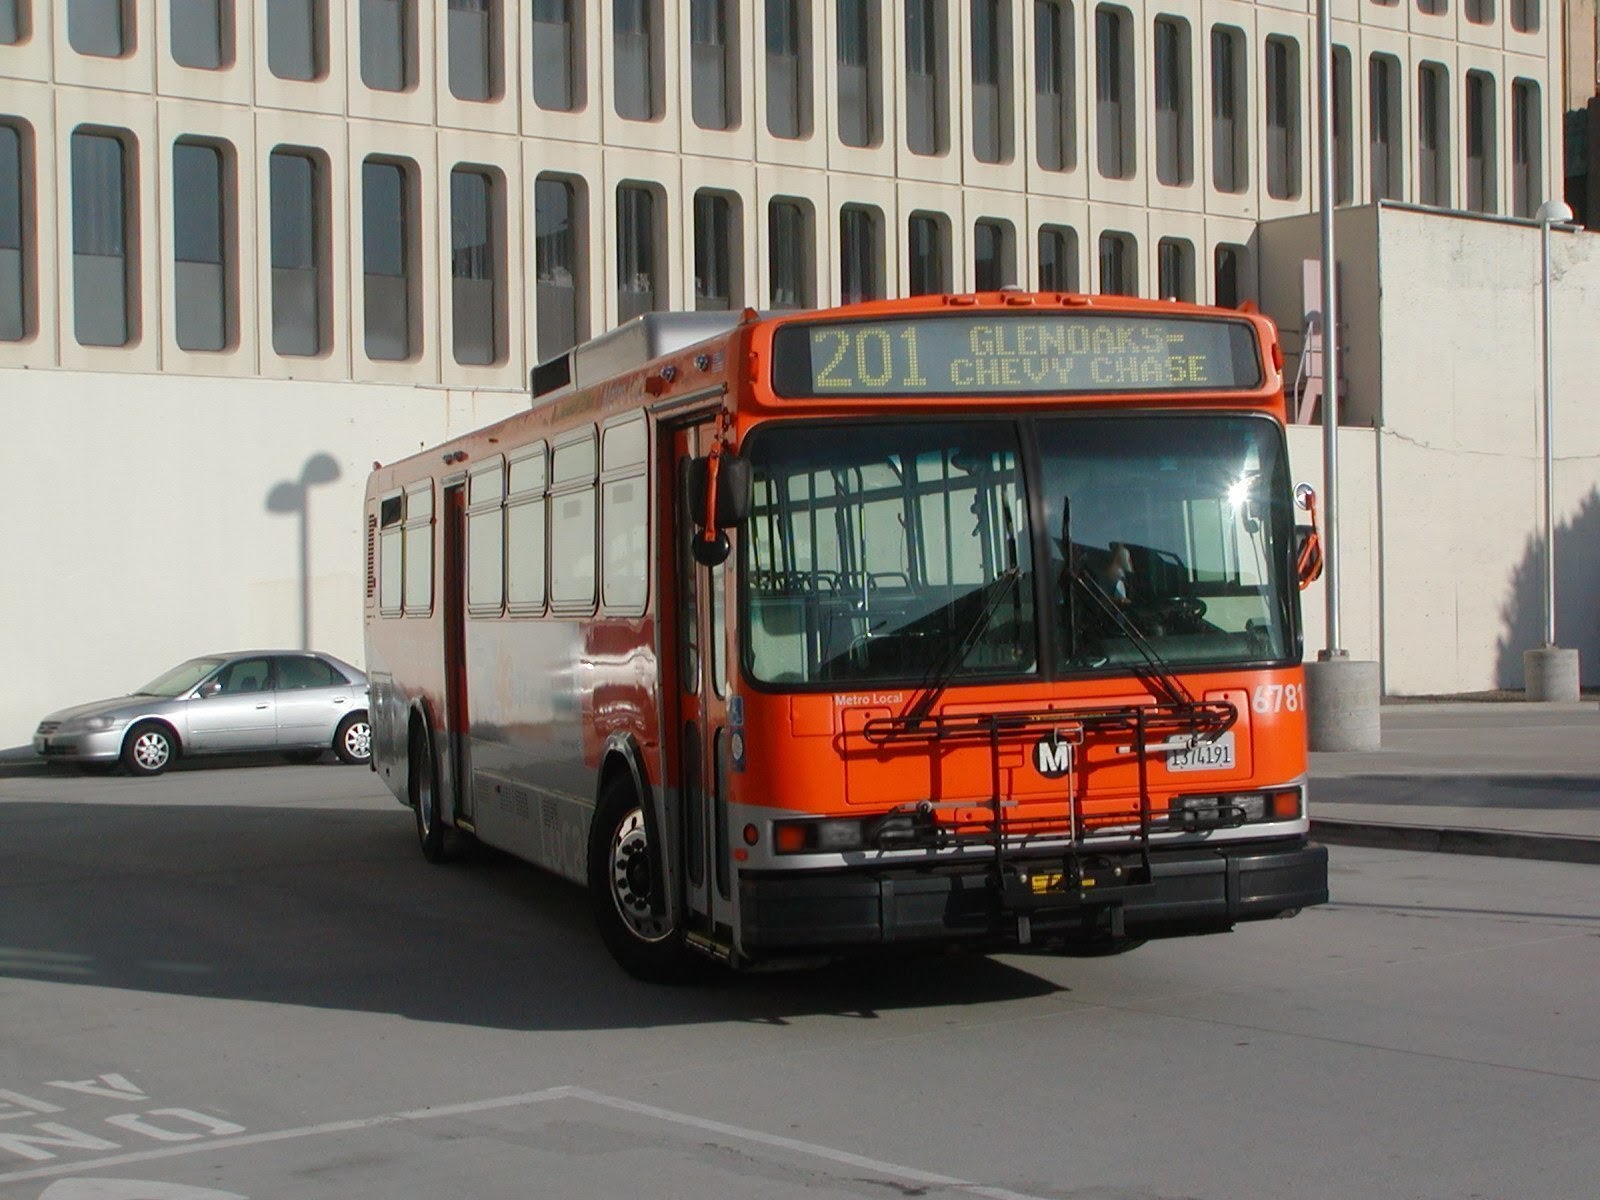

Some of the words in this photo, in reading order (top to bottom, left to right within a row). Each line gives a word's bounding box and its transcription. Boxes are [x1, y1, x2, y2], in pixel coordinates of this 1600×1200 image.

[815, 327, 927, 387] 201
[950, 357, 1075, 386] CHEVY
[1091, 354, 1208, 384] CHASE
[834, 694, 870, 706] Metro
[873, 692, 903, 705] Local
[1252, 683, 1304, 714] 6781
[1039, 741, 1069, 772] M
[1171, 745, 1232, 766] 1374191
